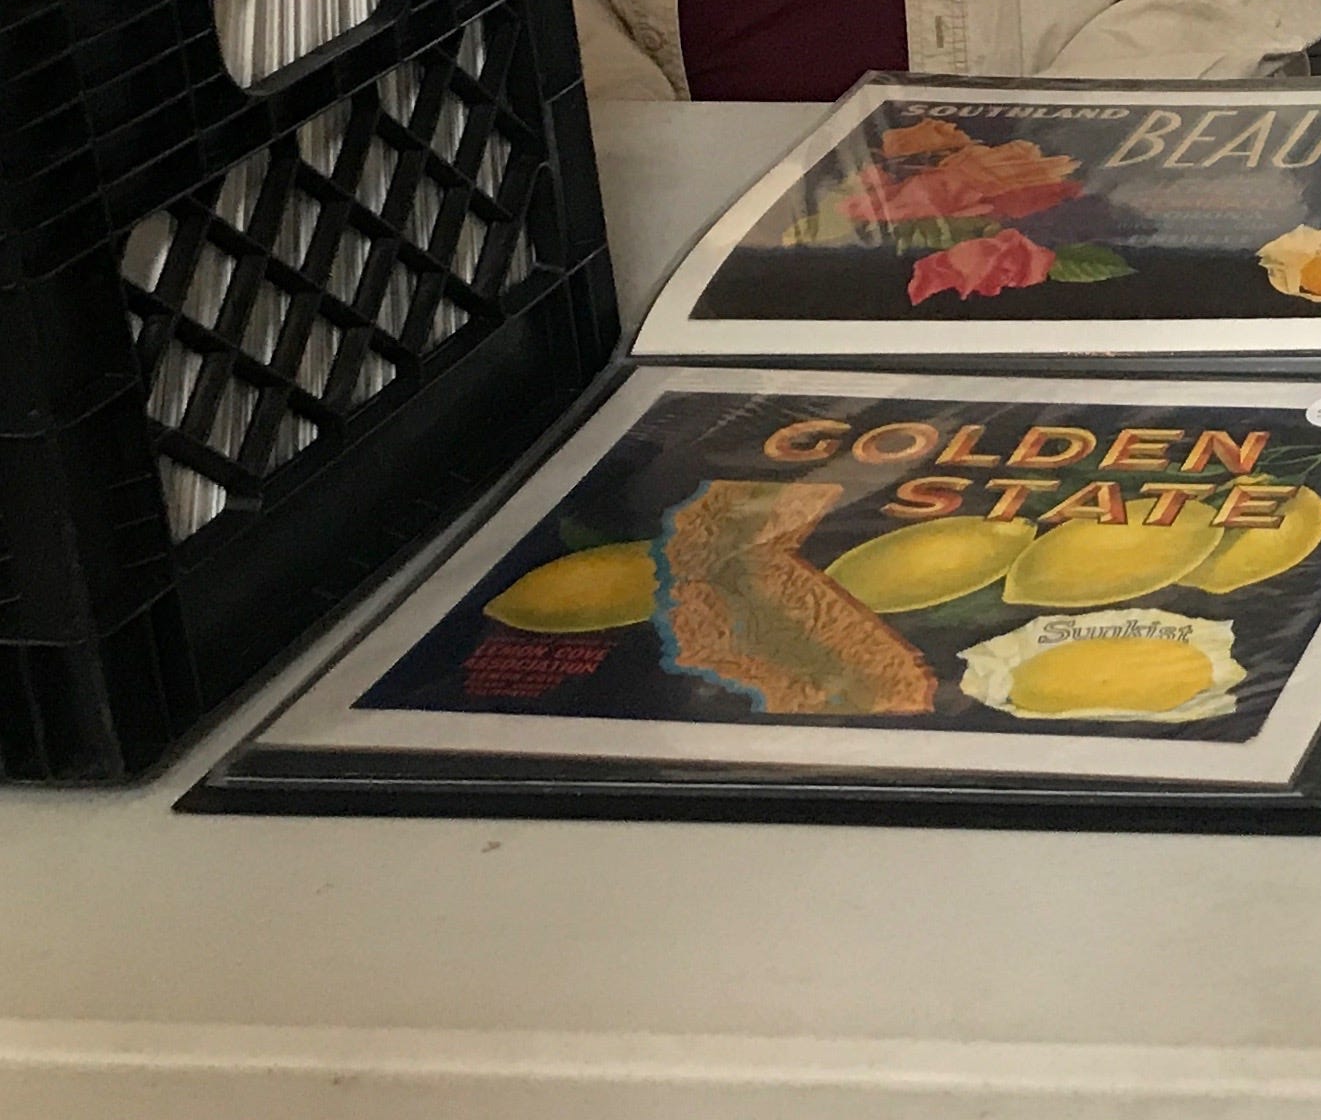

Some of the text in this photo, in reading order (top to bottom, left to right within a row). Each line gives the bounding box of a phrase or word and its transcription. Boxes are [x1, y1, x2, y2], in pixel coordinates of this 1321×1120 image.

[901, 103, 1132, 120] SOUTHLAND
[762, 420, 1271, 476] GOLDEN
[881, 476, 1301, 531] STATE
[1039, 616, 1194, 647] Sunkist
